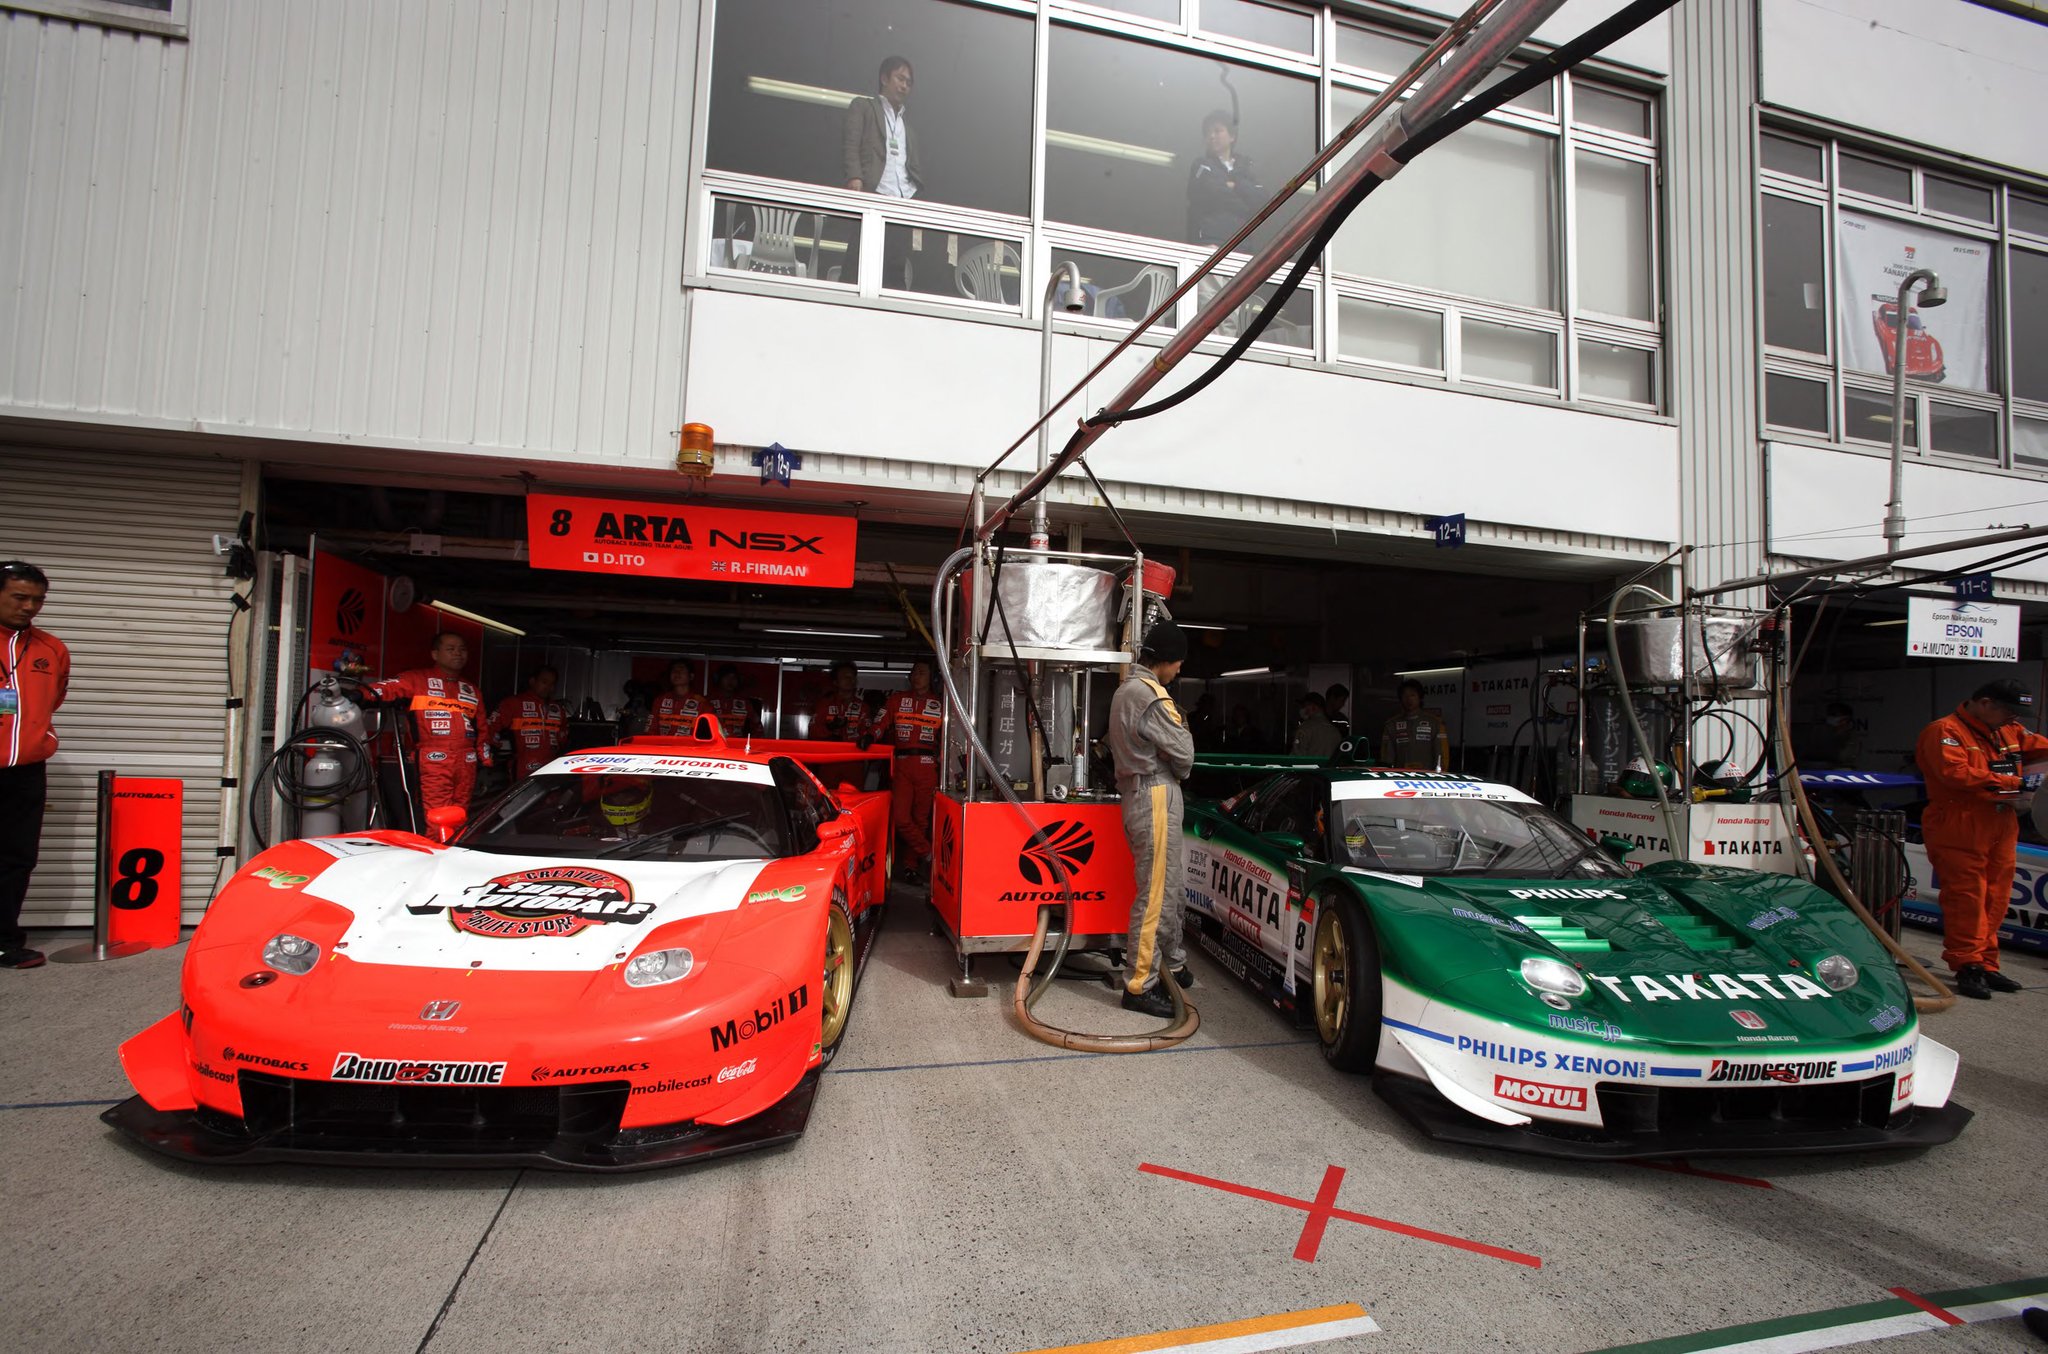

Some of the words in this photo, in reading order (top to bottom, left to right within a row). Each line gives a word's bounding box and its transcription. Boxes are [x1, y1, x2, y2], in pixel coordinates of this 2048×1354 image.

[549, 508, 573, 537] 8
[594, 512, 692, 544] ARTA
[1439, 523, 1461, 540] 12-A
[594, 538, 627, 546] AUTOBACS
[629, 540, 652, 548] RACING
[709, 529, 824, 555] NSX
[603, 552, 646, 567] D.ITO
[730, 560, 806, 578] R.FIRMAN
[1960, 580, 1987, 596] 11-C
[1932, 612, 1950, 621] Epson
[1951, 614, 1977, 623] Nakajima
[1979, 616, 1998, 626] Racing
[1945, 624, 1983, 639] EPSON
[1922, 643, 1955, 656] H.MUTOH
[1958, 645, 1969, 656] 32
[1984, 646, 2016, 660] L.DUVAL
[1482, 678, 1529, 692] TAKATA
[608, 766, 685, 775] SUPER
[655, 758, 749, 771] AUTOBACS
[1362, 772, 1484, 781] TAKATA
[1394, 780, 1482, 791] PHILIPS
[1599, 808, 1626, 818] Honda
[1626, 811, 1656, 823] Racing
[1743, 817, 1770, 825] Racing
[1718, 840, 1782, 855] TAKATA
[1223, 849, 1247, 868] Honda
[1245, 859, 1273, 884] Racing
[111, 847, 165, 910] 8
[525, 869, 609, 884] CREATIVE
[998, 890, 1107, 902] AUTOBACS
[1211, 859, 1280, 931] TAKATA
[1508, 889, 1628, 900] PHILIPS
[518, 915, 576, 935] STORE
[1295, 921, 1306, 950] 8
[1589, 973, 1833, 1003] TAKATA
[710, 999, 784, 1053] Mobil
[787, 984, 808, 1016] 1
[389, 1023, 426, 1031] Honda
[427, 1023, 468, 1033] Racing
[1549, 1013, 1622, 1042] music.jp
[1768, 1035, 1799, 1043] Racing
[236, 1052, 309, 1072] AUTOBACS
[1458, 1035, 1548, 1068] PHILIPS
[1554, 1053, 1639, 1078] XENON
[1875, 1047, 1913, 1071] PHILIPS
[550, 1062, 650, 1078] AUTOBACS
[631, 1074, 713, 1096] mobilecast
[1498, 1079, 1583, 1108] MOTUL
